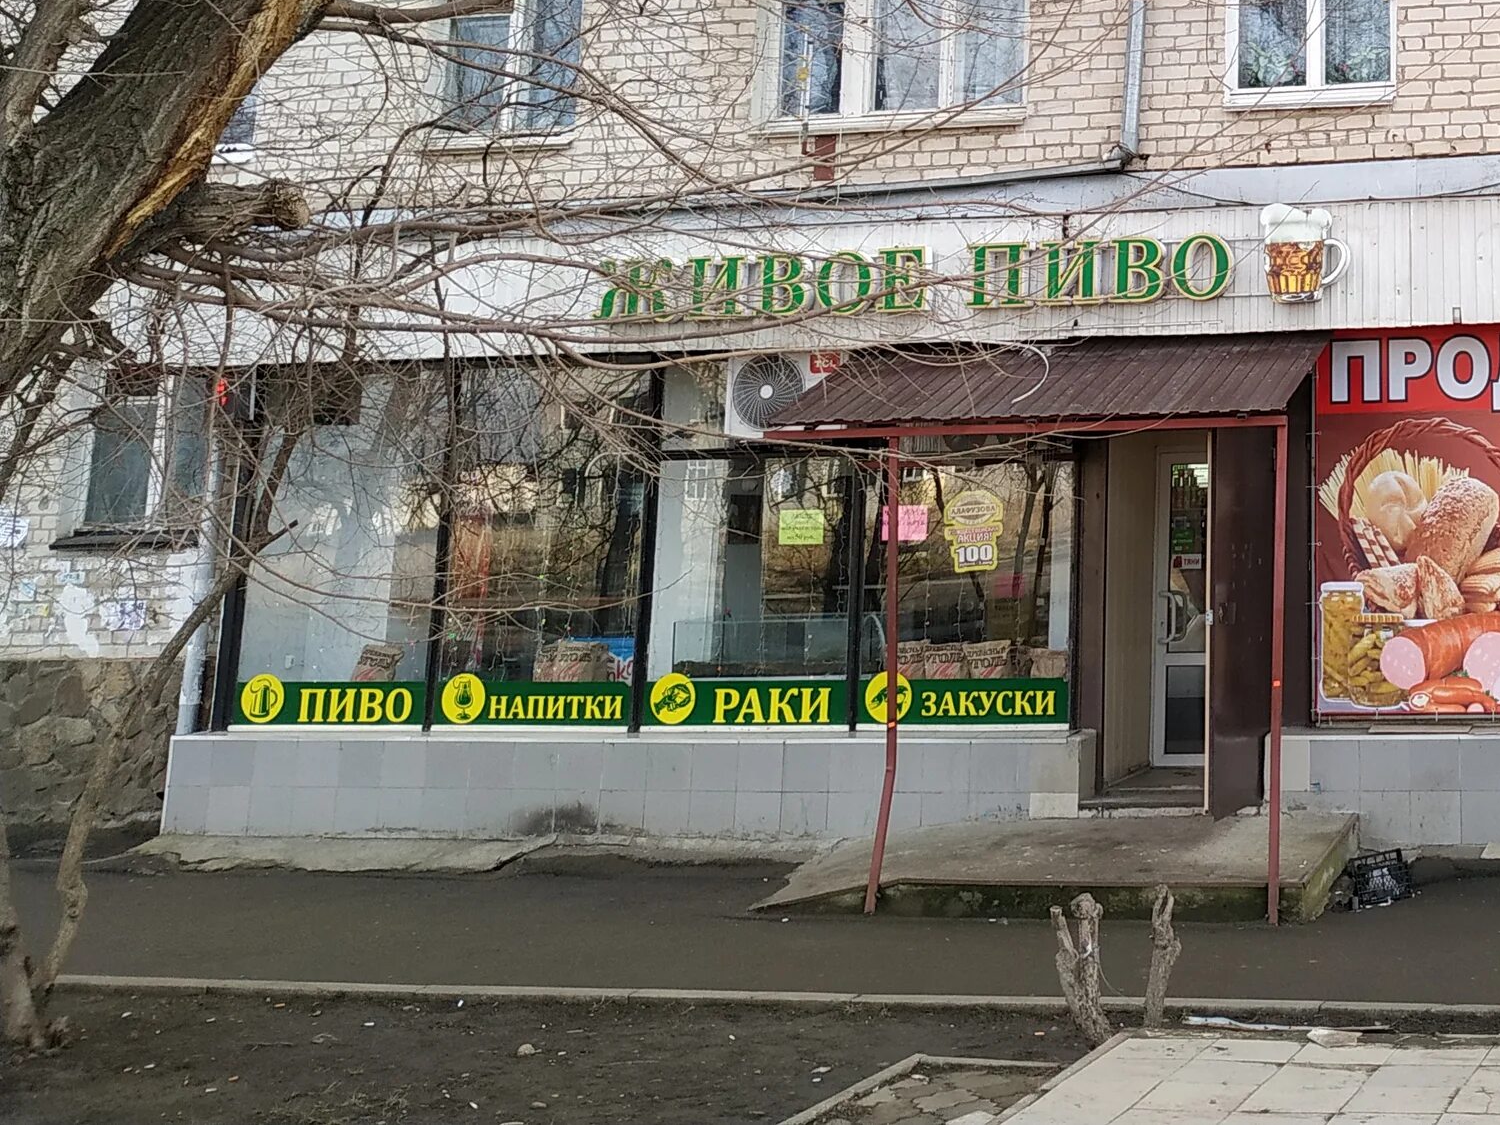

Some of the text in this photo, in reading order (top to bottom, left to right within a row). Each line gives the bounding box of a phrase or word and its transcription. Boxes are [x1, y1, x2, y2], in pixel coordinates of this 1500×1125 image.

[592, 232, 1235, 322] ЖИВОЕ ПИВО
[955, 544, 993, 563] 100
[297, 686, 413, 723] ПИВО
[487, 694, 624, 720] НАПИТКИ
[712, 686, 832, 723] РАКИ
[920, 689, 1057, 718] ЗАКУСКИ
